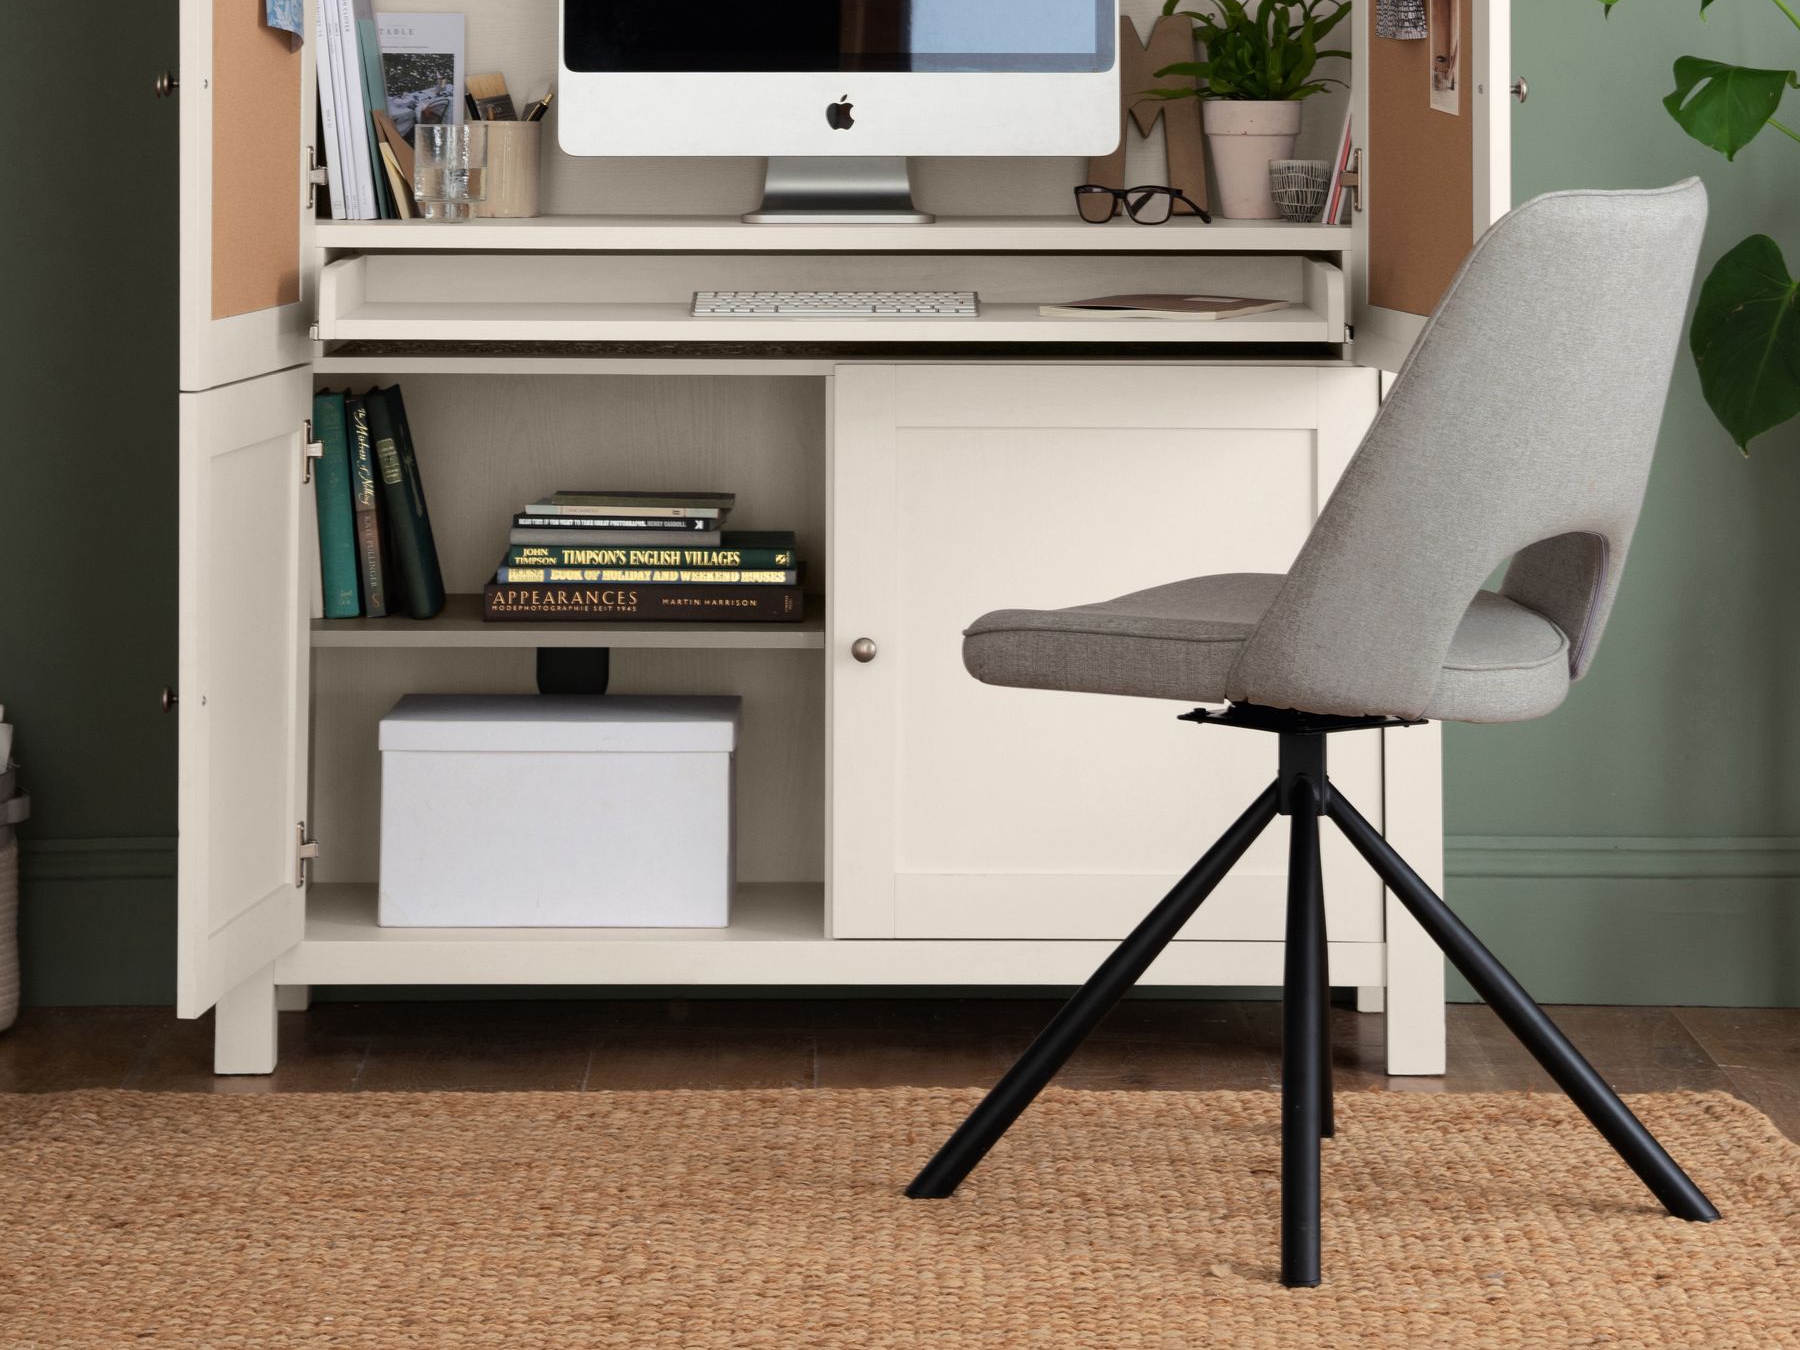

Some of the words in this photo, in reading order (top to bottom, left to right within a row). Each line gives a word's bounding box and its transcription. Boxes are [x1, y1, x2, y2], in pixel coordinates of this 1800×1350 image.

[379, 28, 417, 36] TABLE
[1087, 15, 1208, 215] M
[364, 515, 372, 539] KATE
[523, 548, 548, 556] JOHN
[562, 549, 627, 565] TIMPSON'S
[629, 550, 681, 565] ENGLISH
[684, 551, 741, 566] VILLAGES
[366, 540, 378, 587] PULLINGER
[514, 557, 556, 565] TIMPSON
[550, 569, 583, 580] BOOK
[584, 569, 601, 580] OF
[602, 570, 652, 581] HOLIDAY
[653, 570, 680, 581] AND
[680, 570, 740, 582] WEEKEND
[741, 571, 786, 582] HOUSES
[493, 590, 638, 605] APPEARANCES
[704, 599, 757, 607] HARRISON
